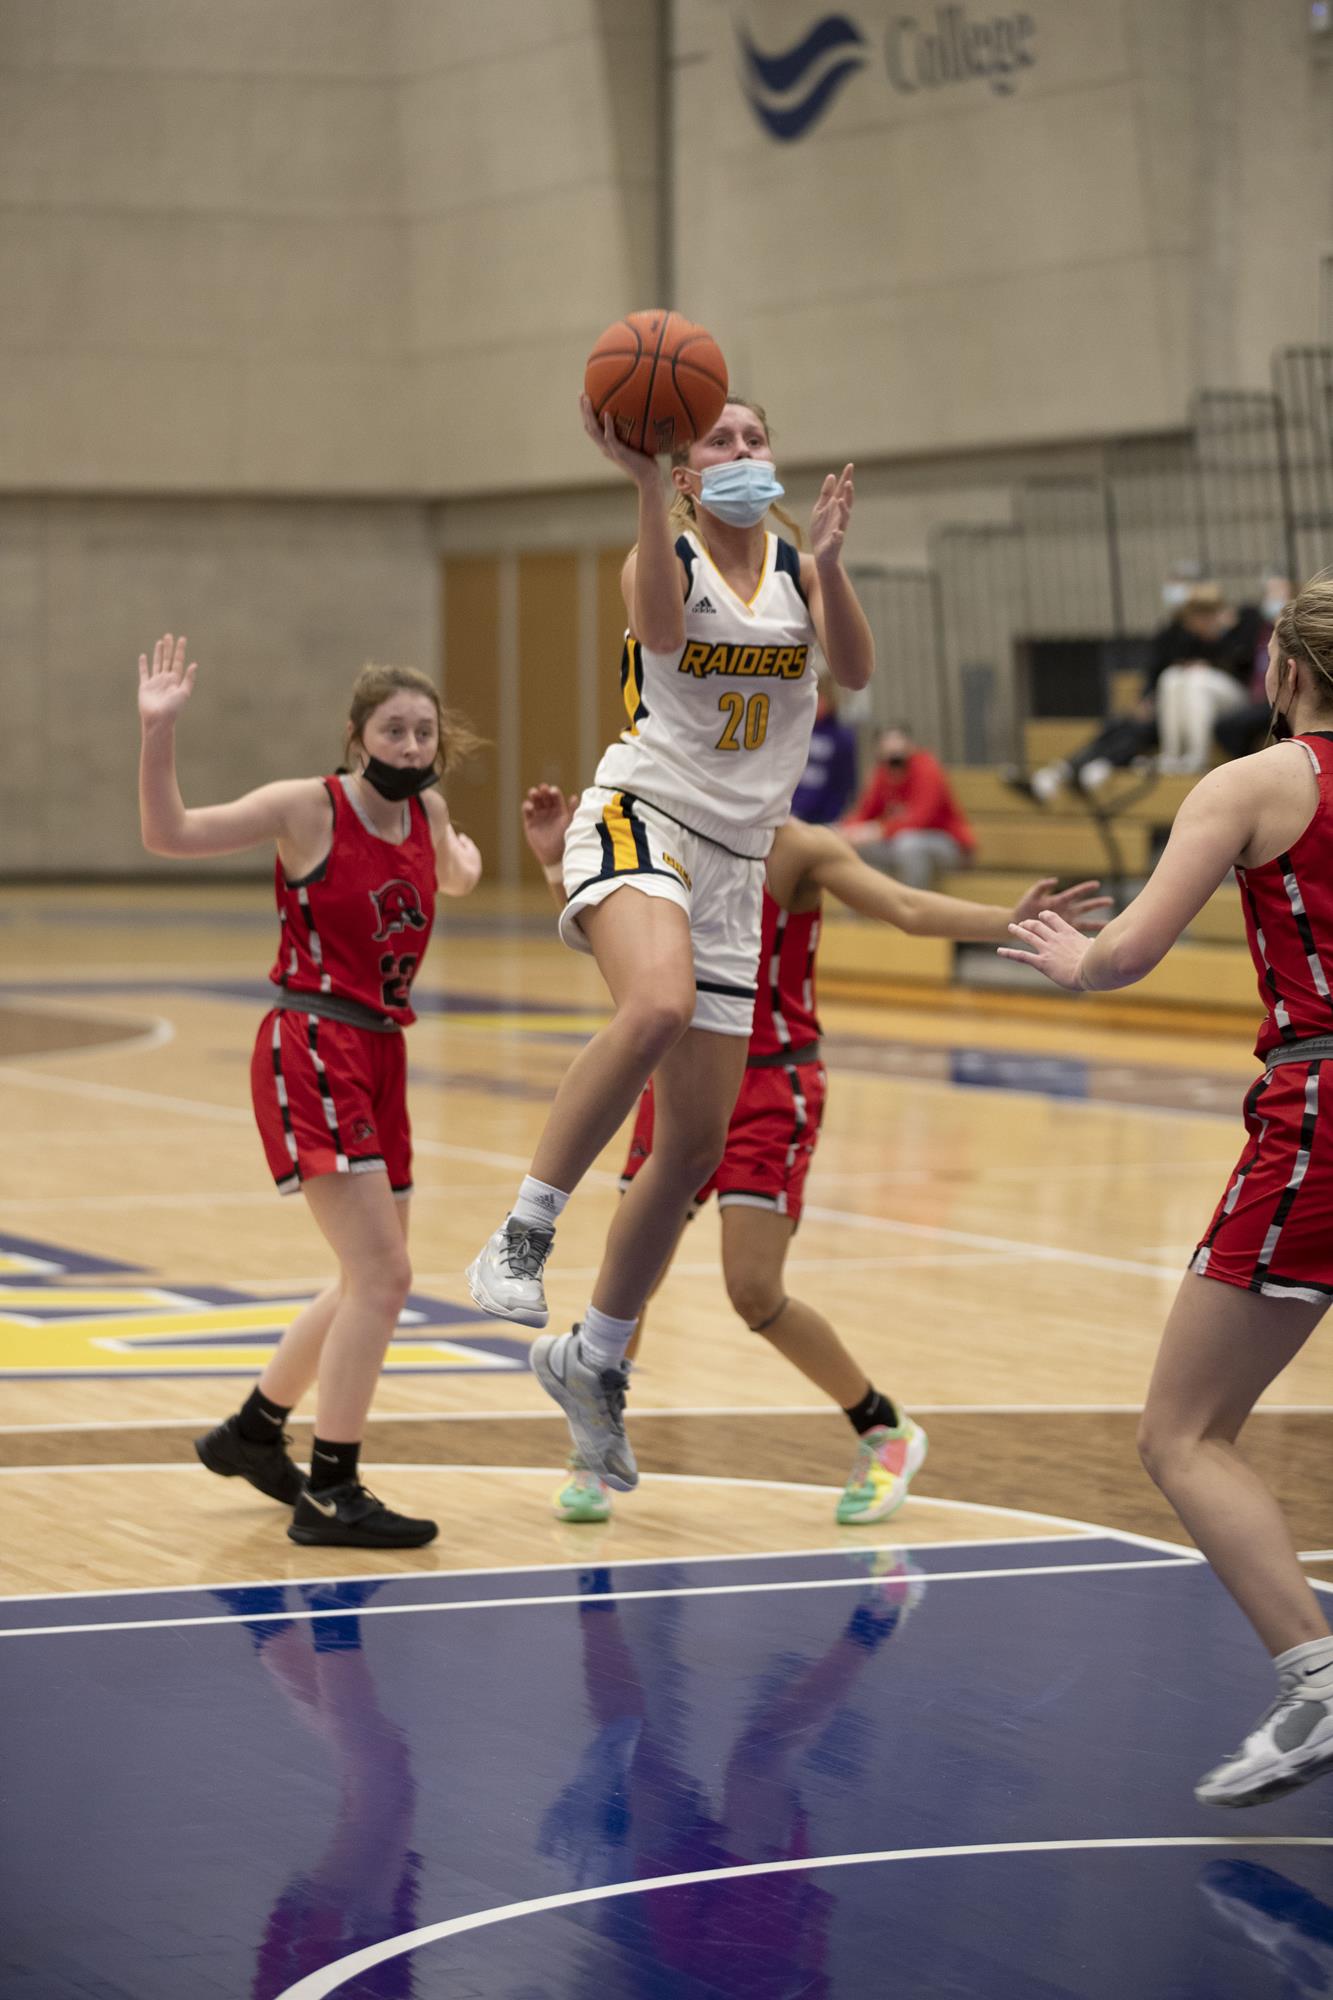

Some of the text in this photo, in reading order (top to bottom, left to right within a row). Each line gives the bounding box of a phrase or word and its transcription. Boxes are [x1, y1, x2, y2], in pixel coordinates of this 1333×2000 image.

[884, 2, 1035, 95] College
[678, 640, 808, 679] RAIDERS
[714, 691, 770, 751] 20
